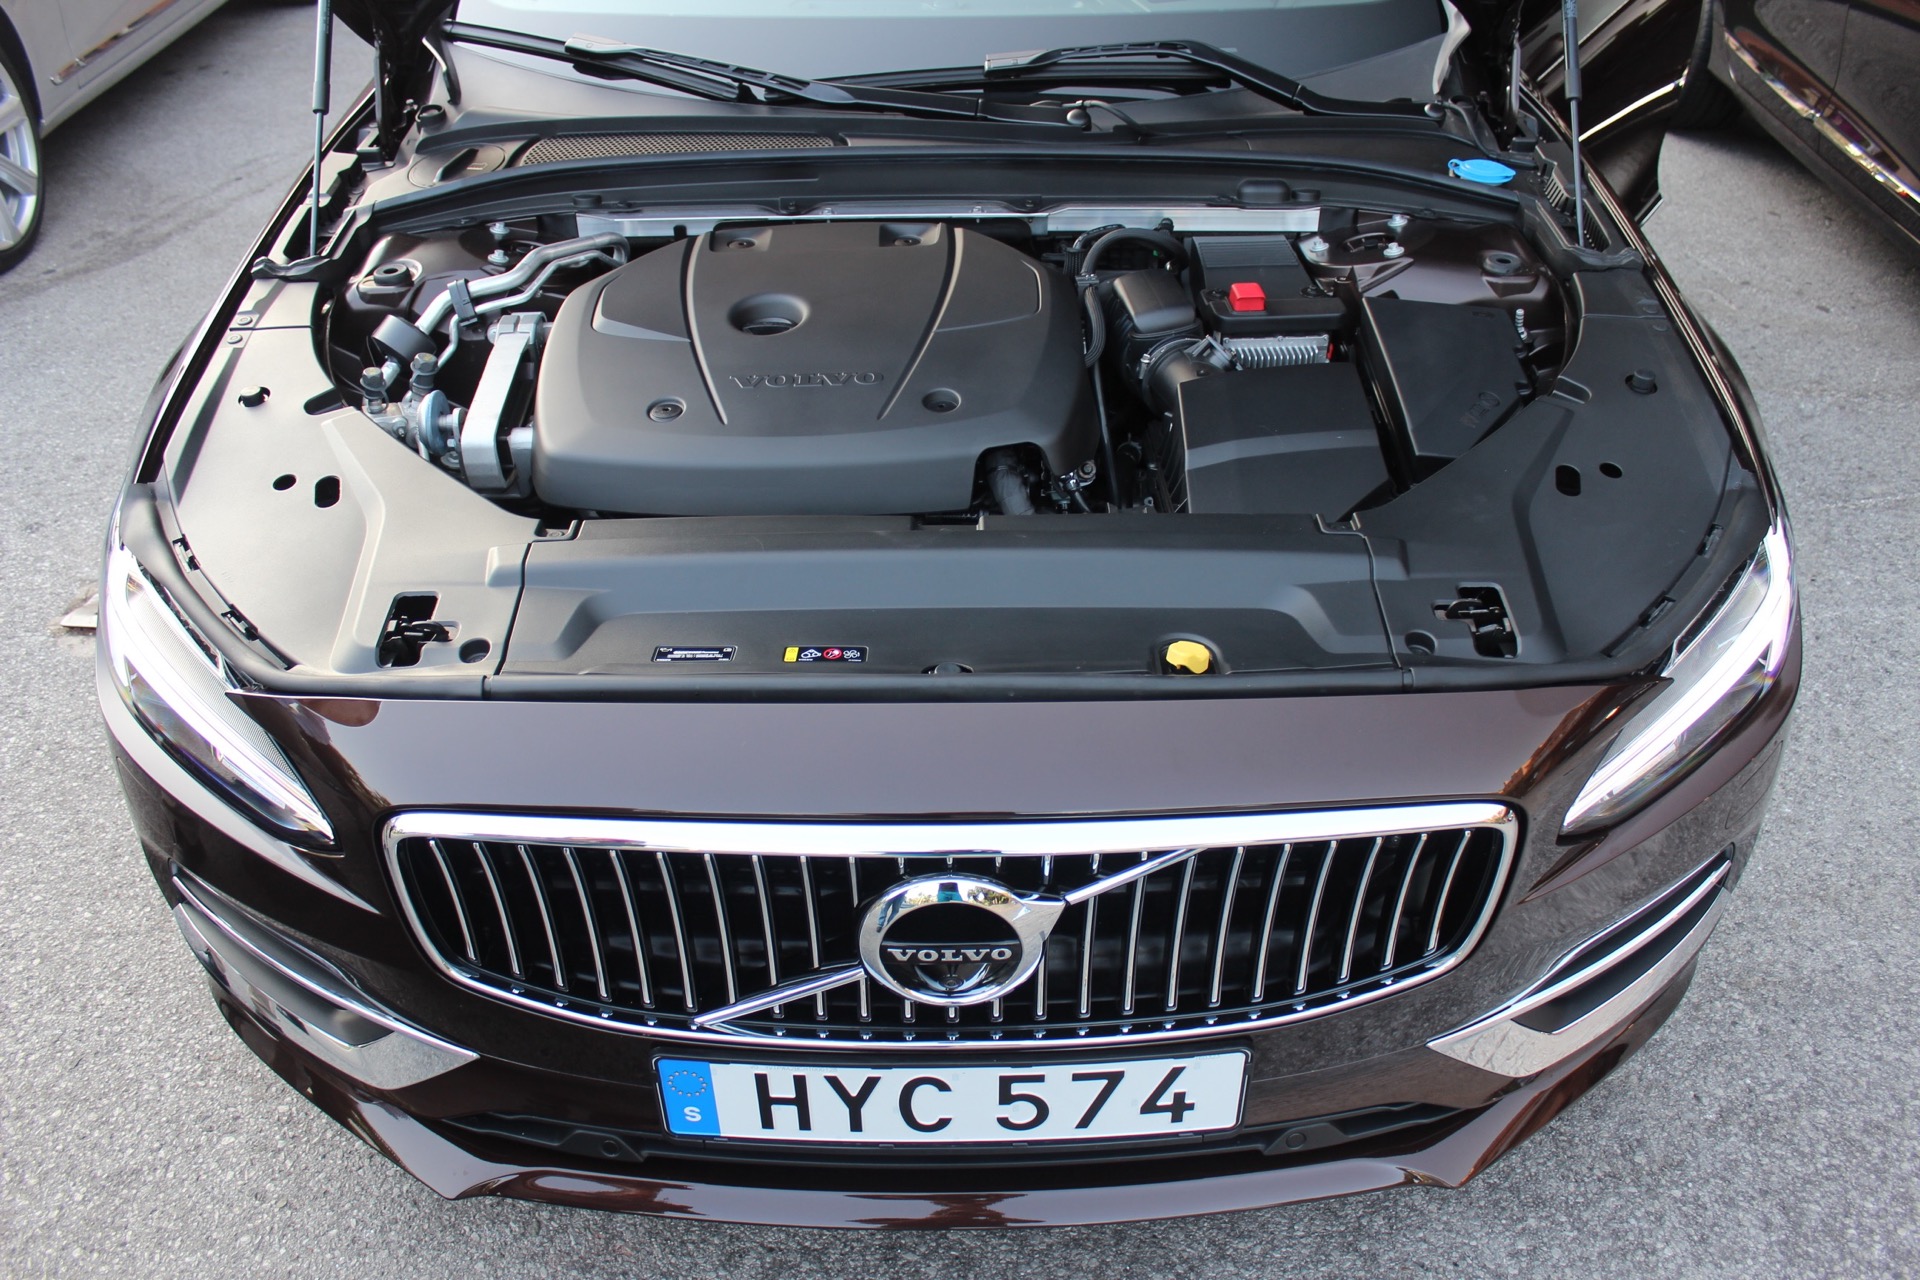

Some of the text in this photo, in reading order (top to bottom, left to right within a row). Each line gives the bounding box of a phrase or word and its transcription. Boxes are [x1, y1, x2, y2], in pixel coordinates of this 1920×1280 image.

[729, 372, 884, 388] VOLVO
[887, 948, 1012, 962] VOLVO
[754, 1065, 1196, 1133] HYC 574
[683, 1106, 702, 1122] S
